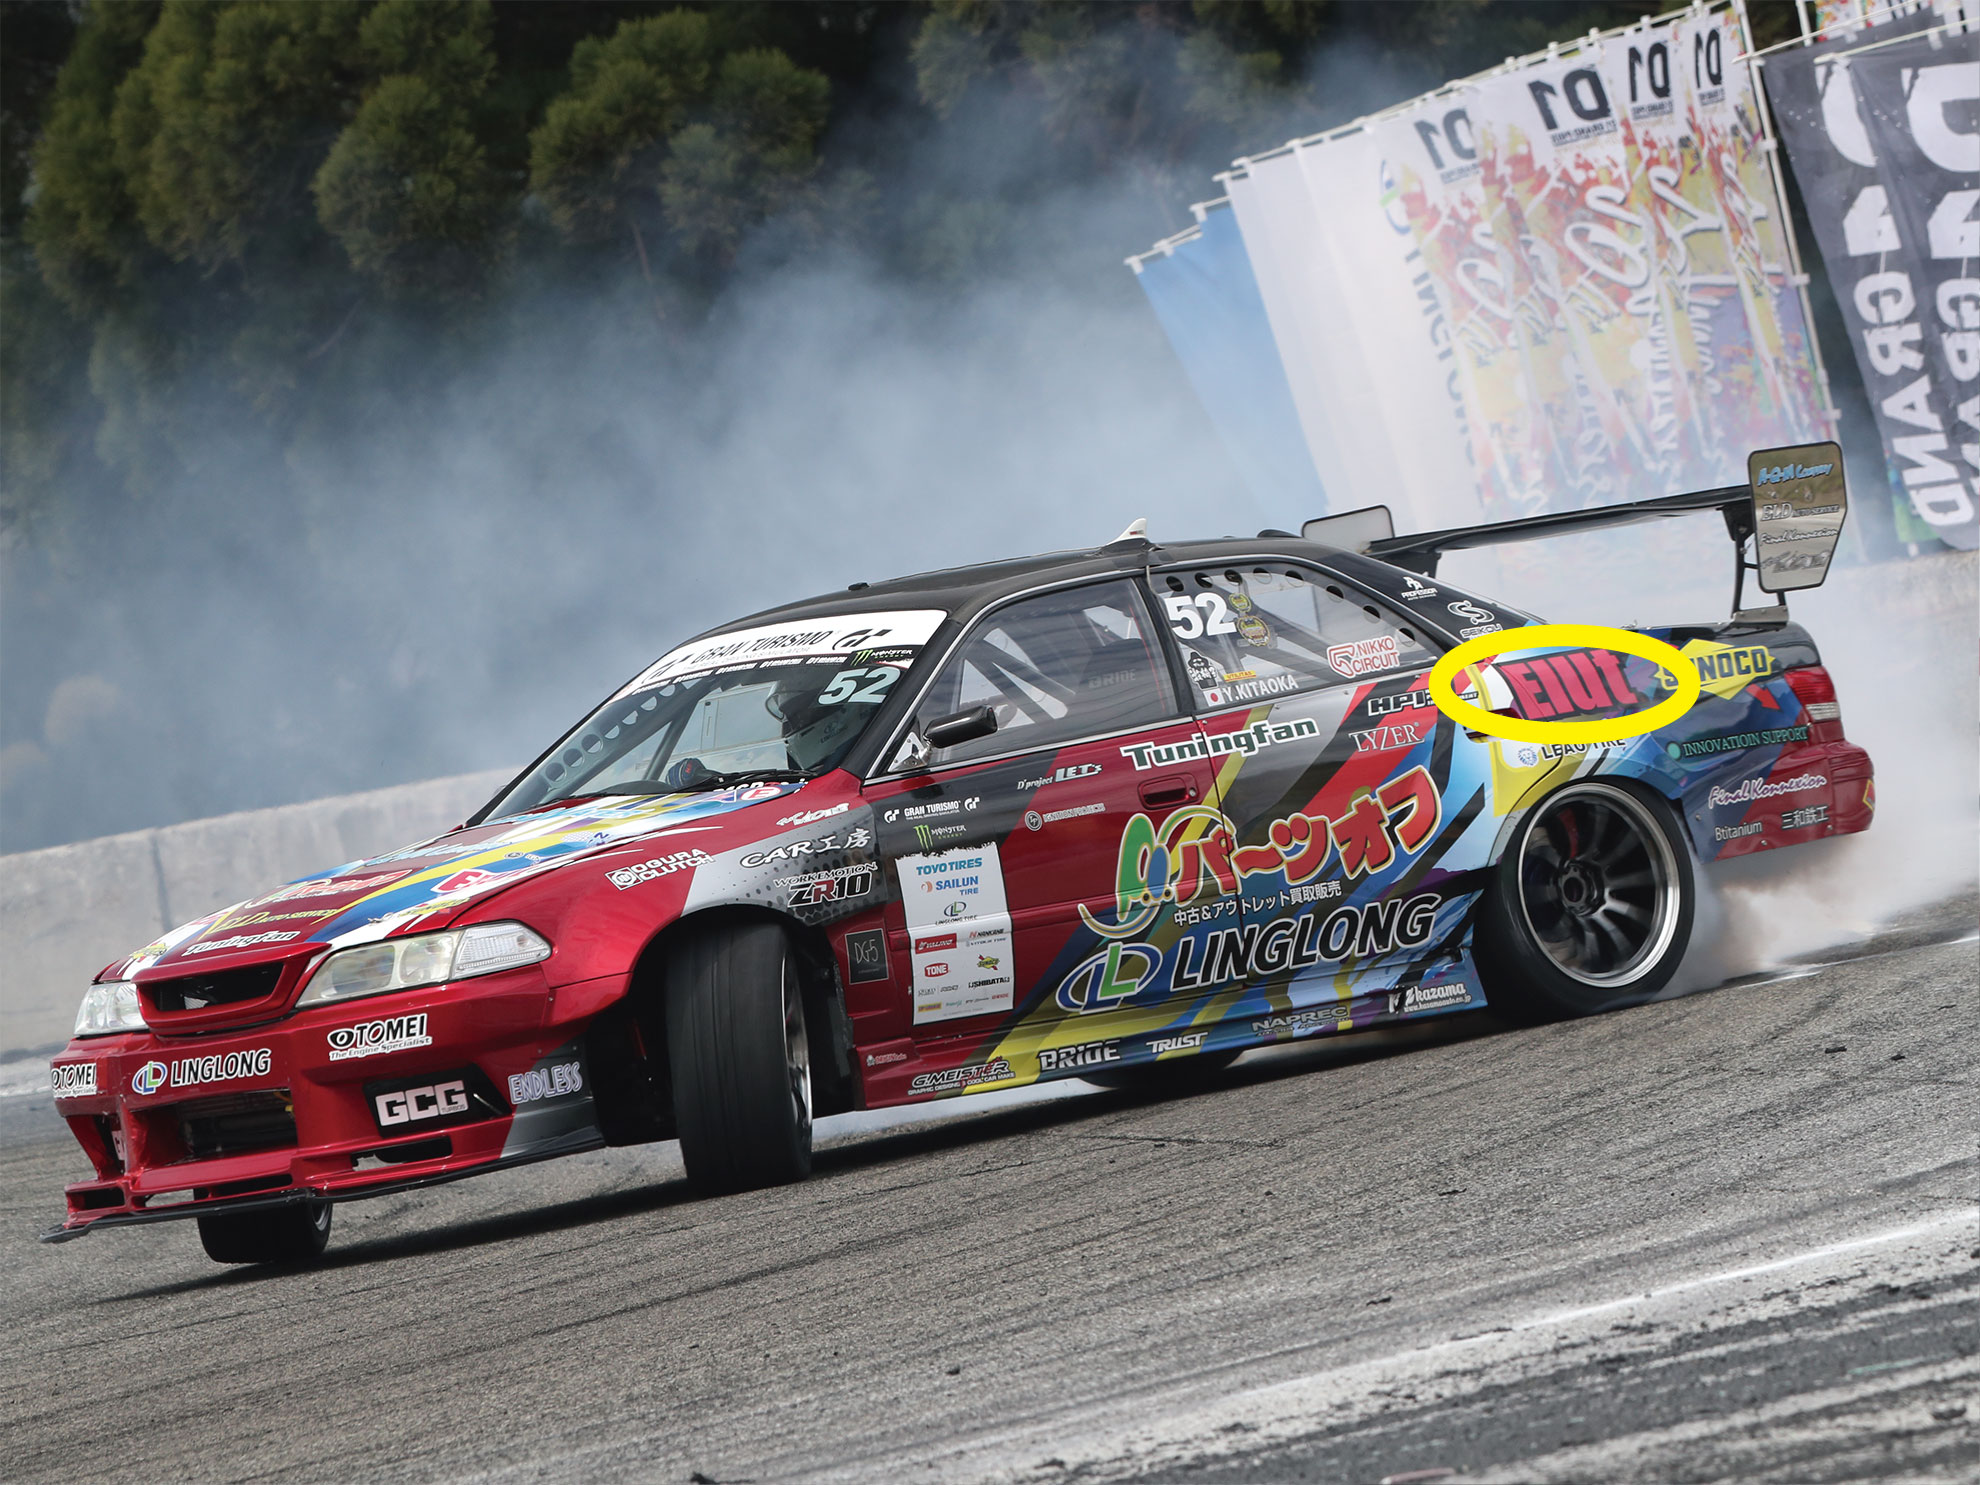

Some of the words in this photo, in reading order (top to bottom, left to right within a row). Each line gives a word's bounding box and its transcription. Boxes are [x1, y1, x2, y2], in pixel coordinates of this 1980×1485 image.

[1164, 592, 1237, 640] 52
[750, 629, 834, 654] TURISMO
[1357, 638, 1395, 656] NIKKO
[1354, 652, 1399, 673] CIRCUIT
[1664, 649, 1768, 686] SNOCO
[818, 666, 901, 705] 52
[1223, 674, 1299, 702] Y.KITAOKA
[1120, 718, 1319, 771] Tuningfan
[1349, 723, 1424, 752] LYZER
[1762, 726, 1808, 745] SUPPORT
[1709, 779, 1750, 809] Final
[904, 804, 927, 817] GRAN
[926, 800, 960, 812] TURISMO
[1714, 822, 1763, 842] Btitanium
[632, 848, 706, 872] OGURA
[638, 853, 714, 882] CLUTCH
[916, 863, 948, 876] TOYO
[948, 857, 983, 871] TIRES
[787, 870, 872, 908] ZR10
[935, 876, 979, 891] SAILUN
[959, 887, 979, 896] TIRE
[1169, 892, 1441, 991] LINGLONG
[926, 964, 948, 975] TONE
[1252, 1007, 1348, 1032] NAPREC
[330, 1050, 347, 1060] The
[349, 1044, 378, 1058] Engine
[380, 1036, 430, 1053] Specialist
[1146, 1032, 1208, 1054] TRUST
[170, 1050, 272, 1087] LINGLONG
[508, 1062, 582, 1104] ENDLESS
[376, 1080, 468, 1126] GCG
